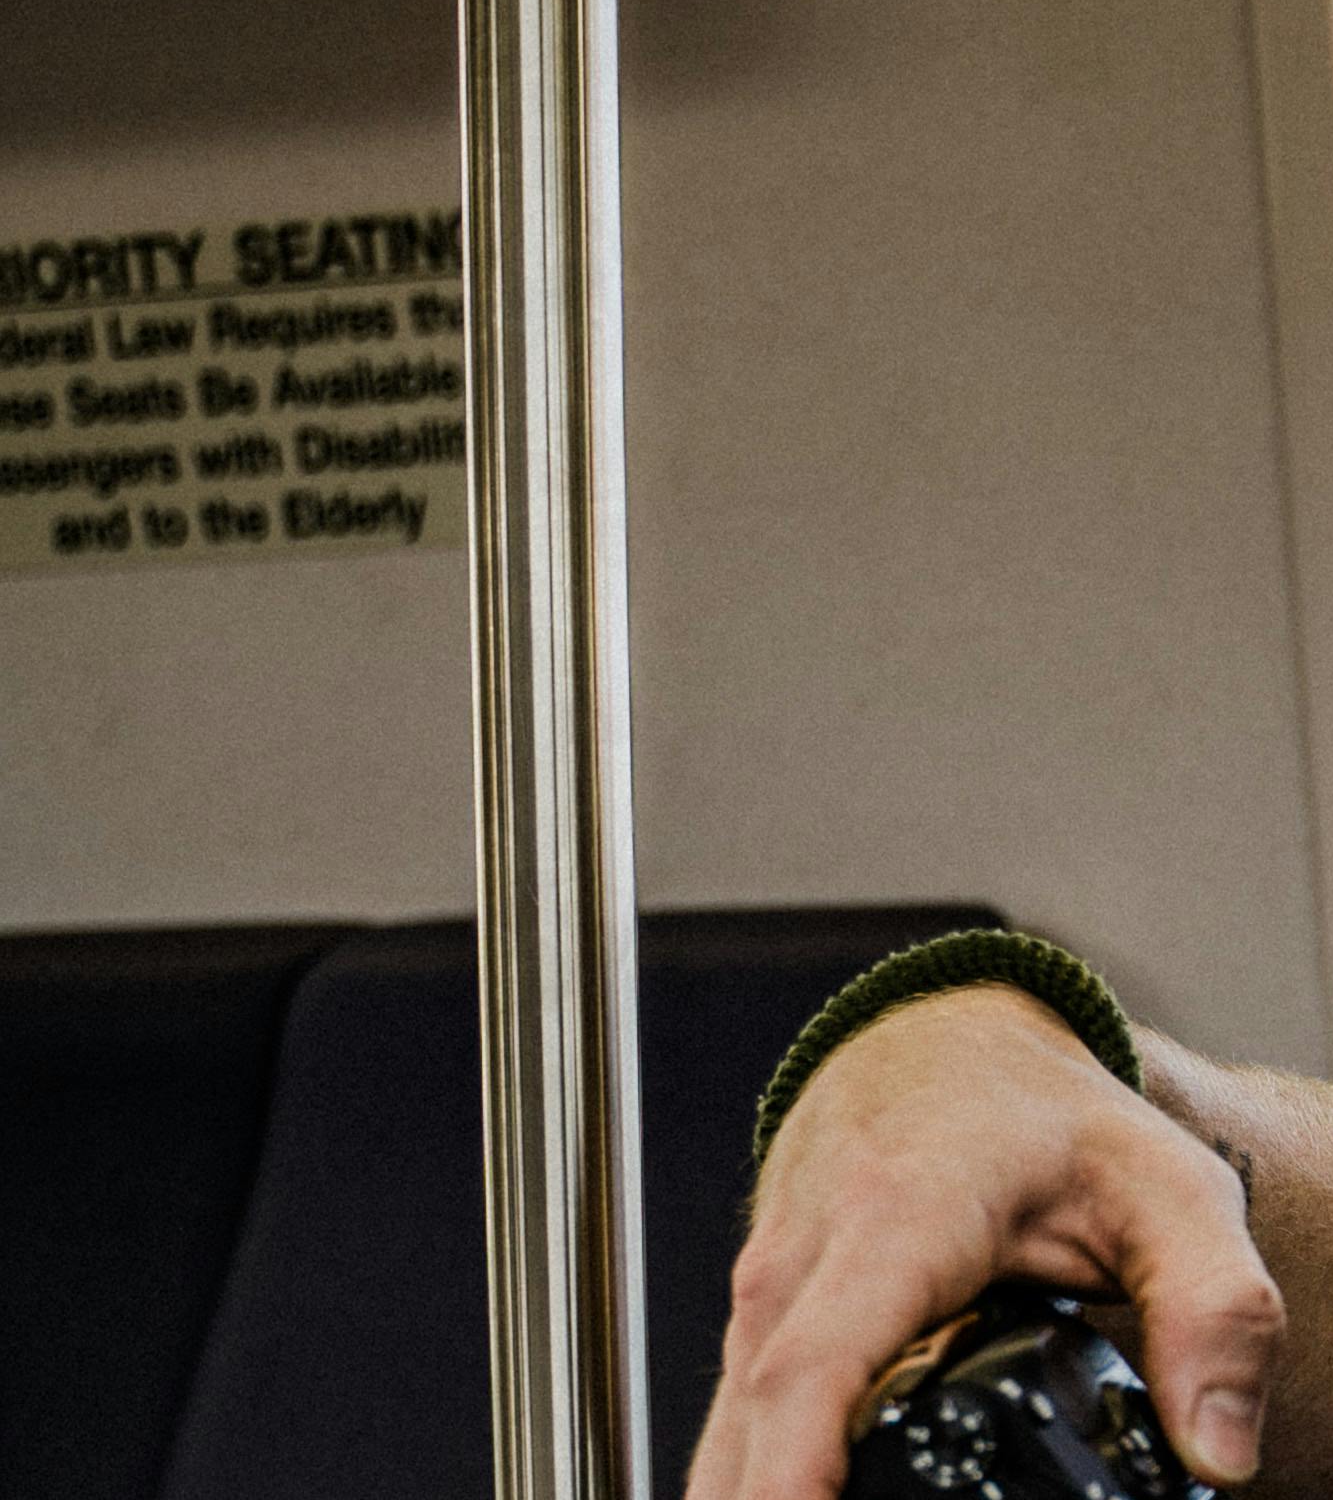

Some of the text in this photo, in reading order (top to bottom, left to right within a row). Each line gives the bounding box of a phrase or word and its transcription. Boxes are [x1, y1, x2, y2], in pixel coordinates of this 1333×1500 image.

[0, 227, 205, 304] IORITY
[106, 316, 195, 361] Law
[208, 300, 396, 355] Requires
[196, 366, 258, 418] Be
[272, 354, 461, 409] Available
[193, 430, 282, 480] with
[52, 488, 428, 554] and to the Elderly
